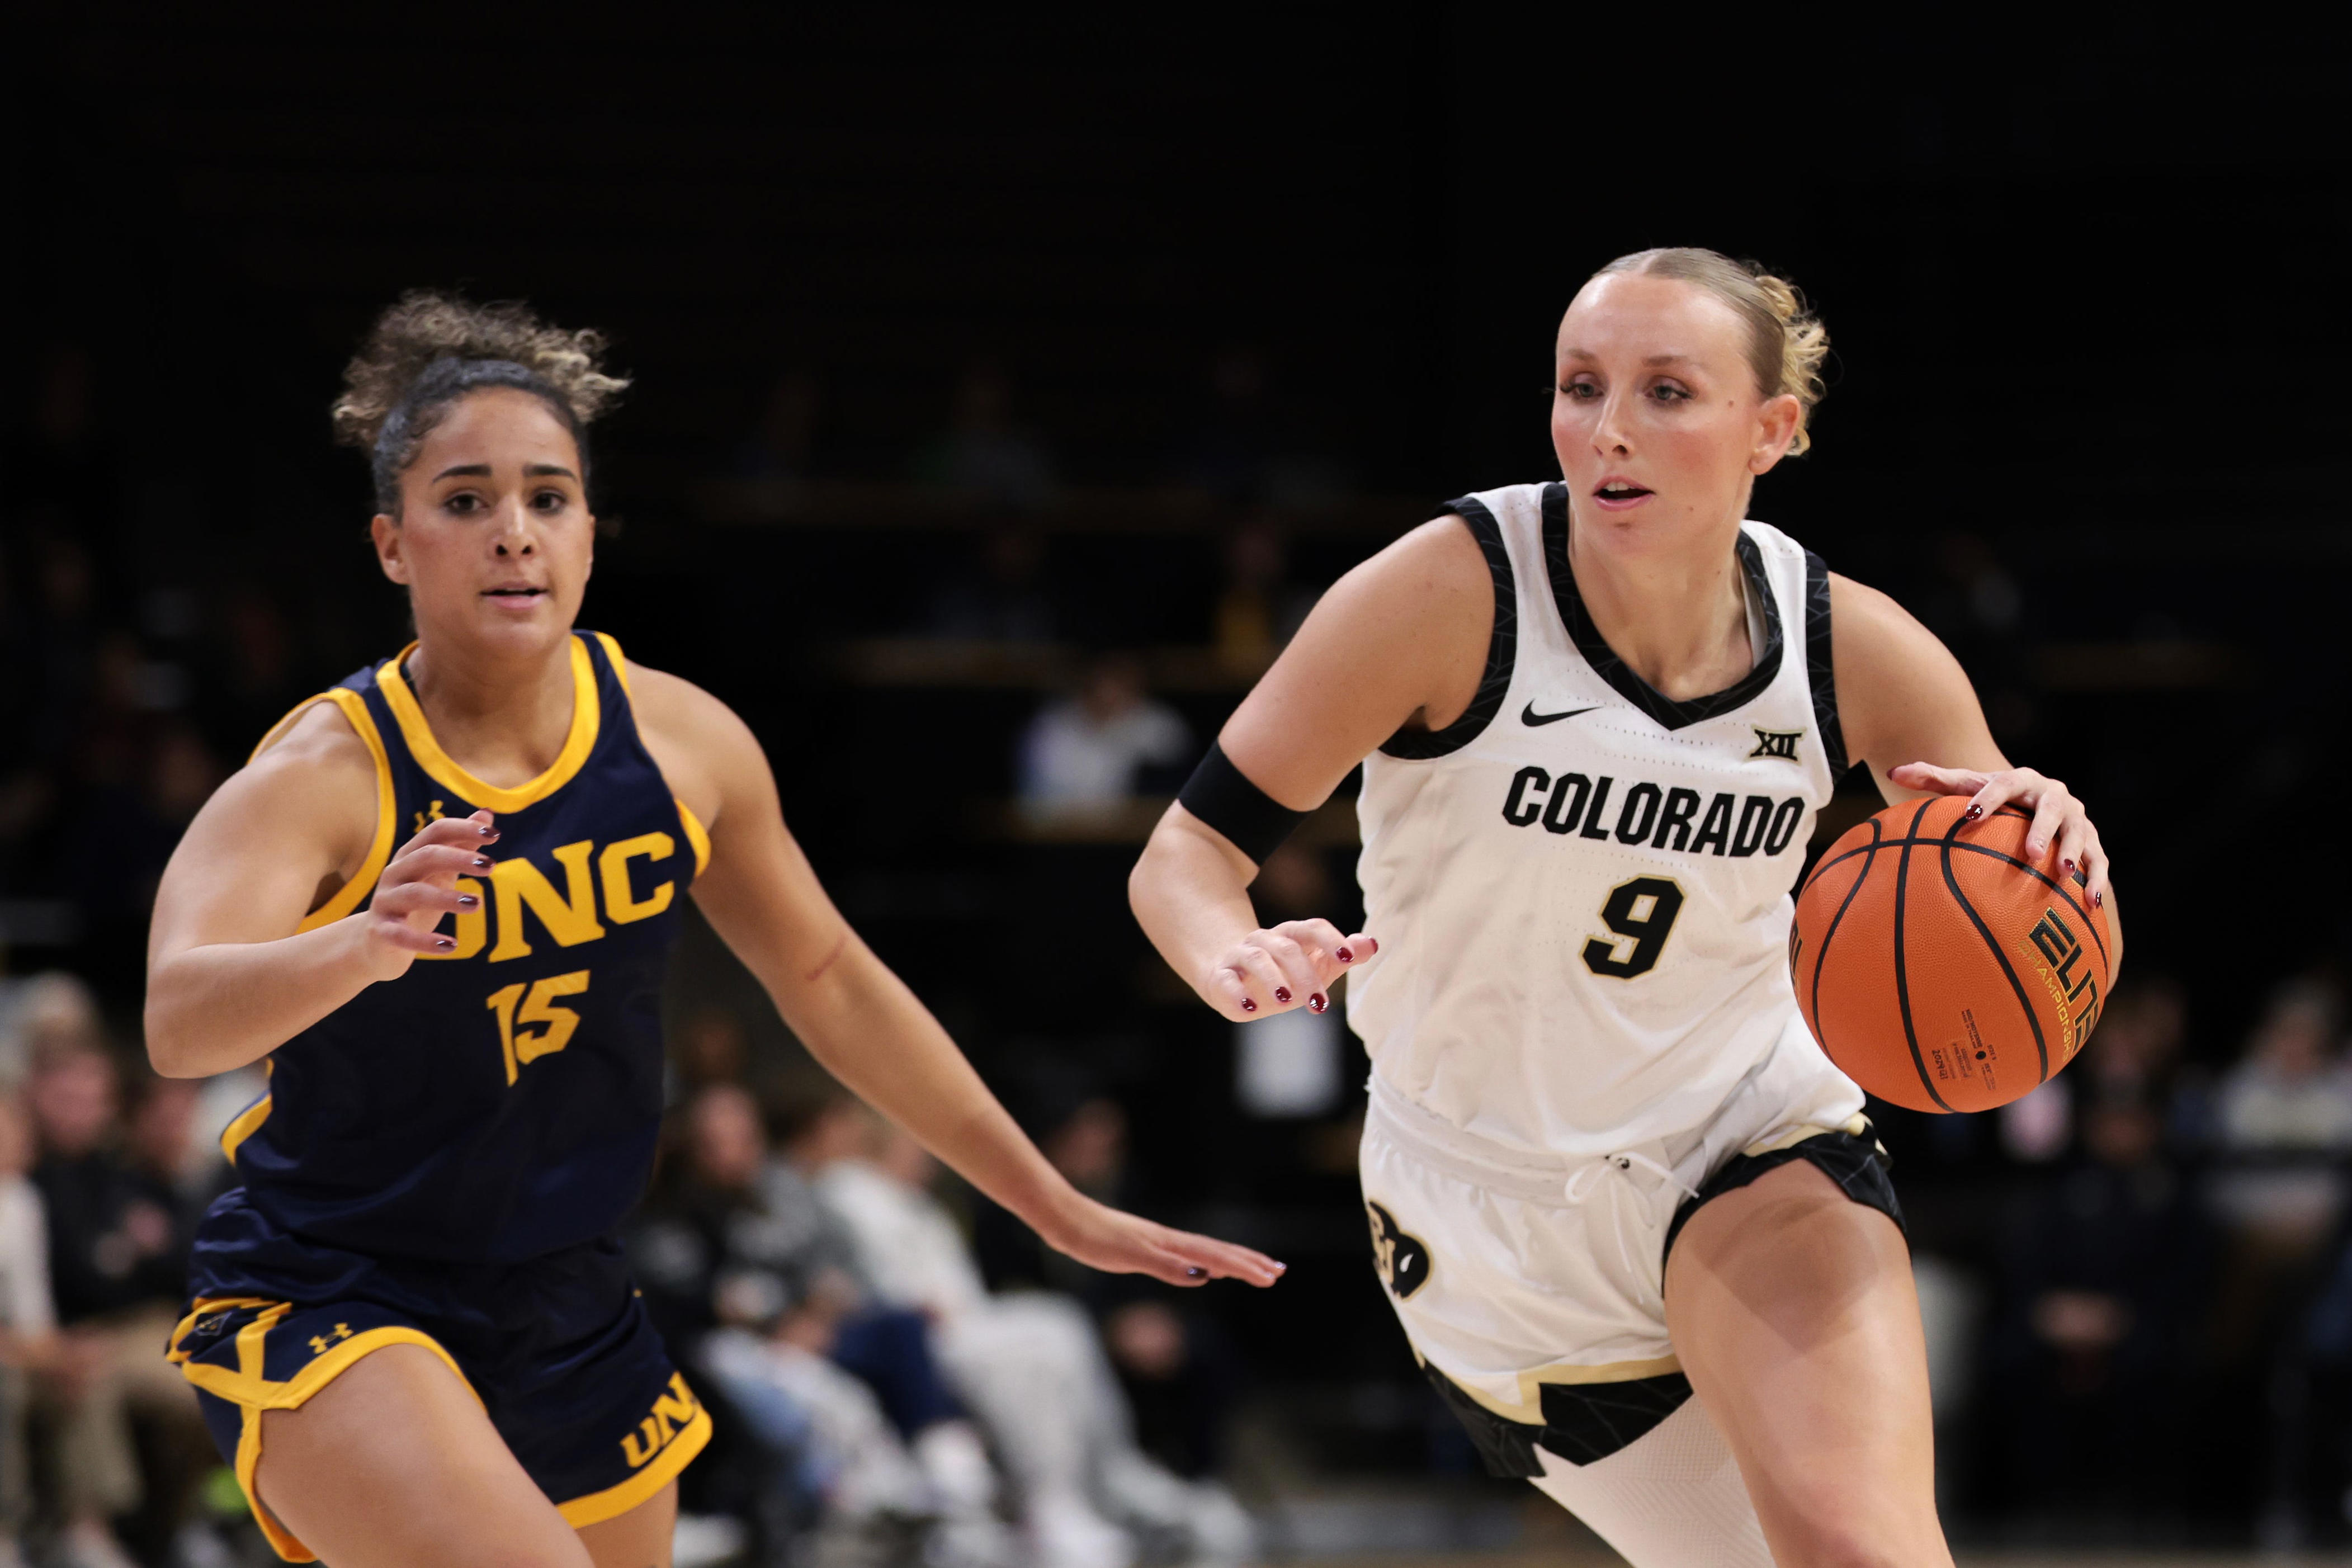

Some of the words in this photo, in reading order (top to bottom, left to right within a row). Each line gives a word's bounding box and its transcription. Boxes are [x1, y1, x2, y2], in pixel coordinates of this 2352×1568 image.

[1749, 728, 1802, 761] XII
[1502, 766, 1805, 858] COLORADO
[1578, 873, 1687, 981] 9
[2028, 907, 2098, 1054] ELITE
[486, 969, 591, 1087] 15
